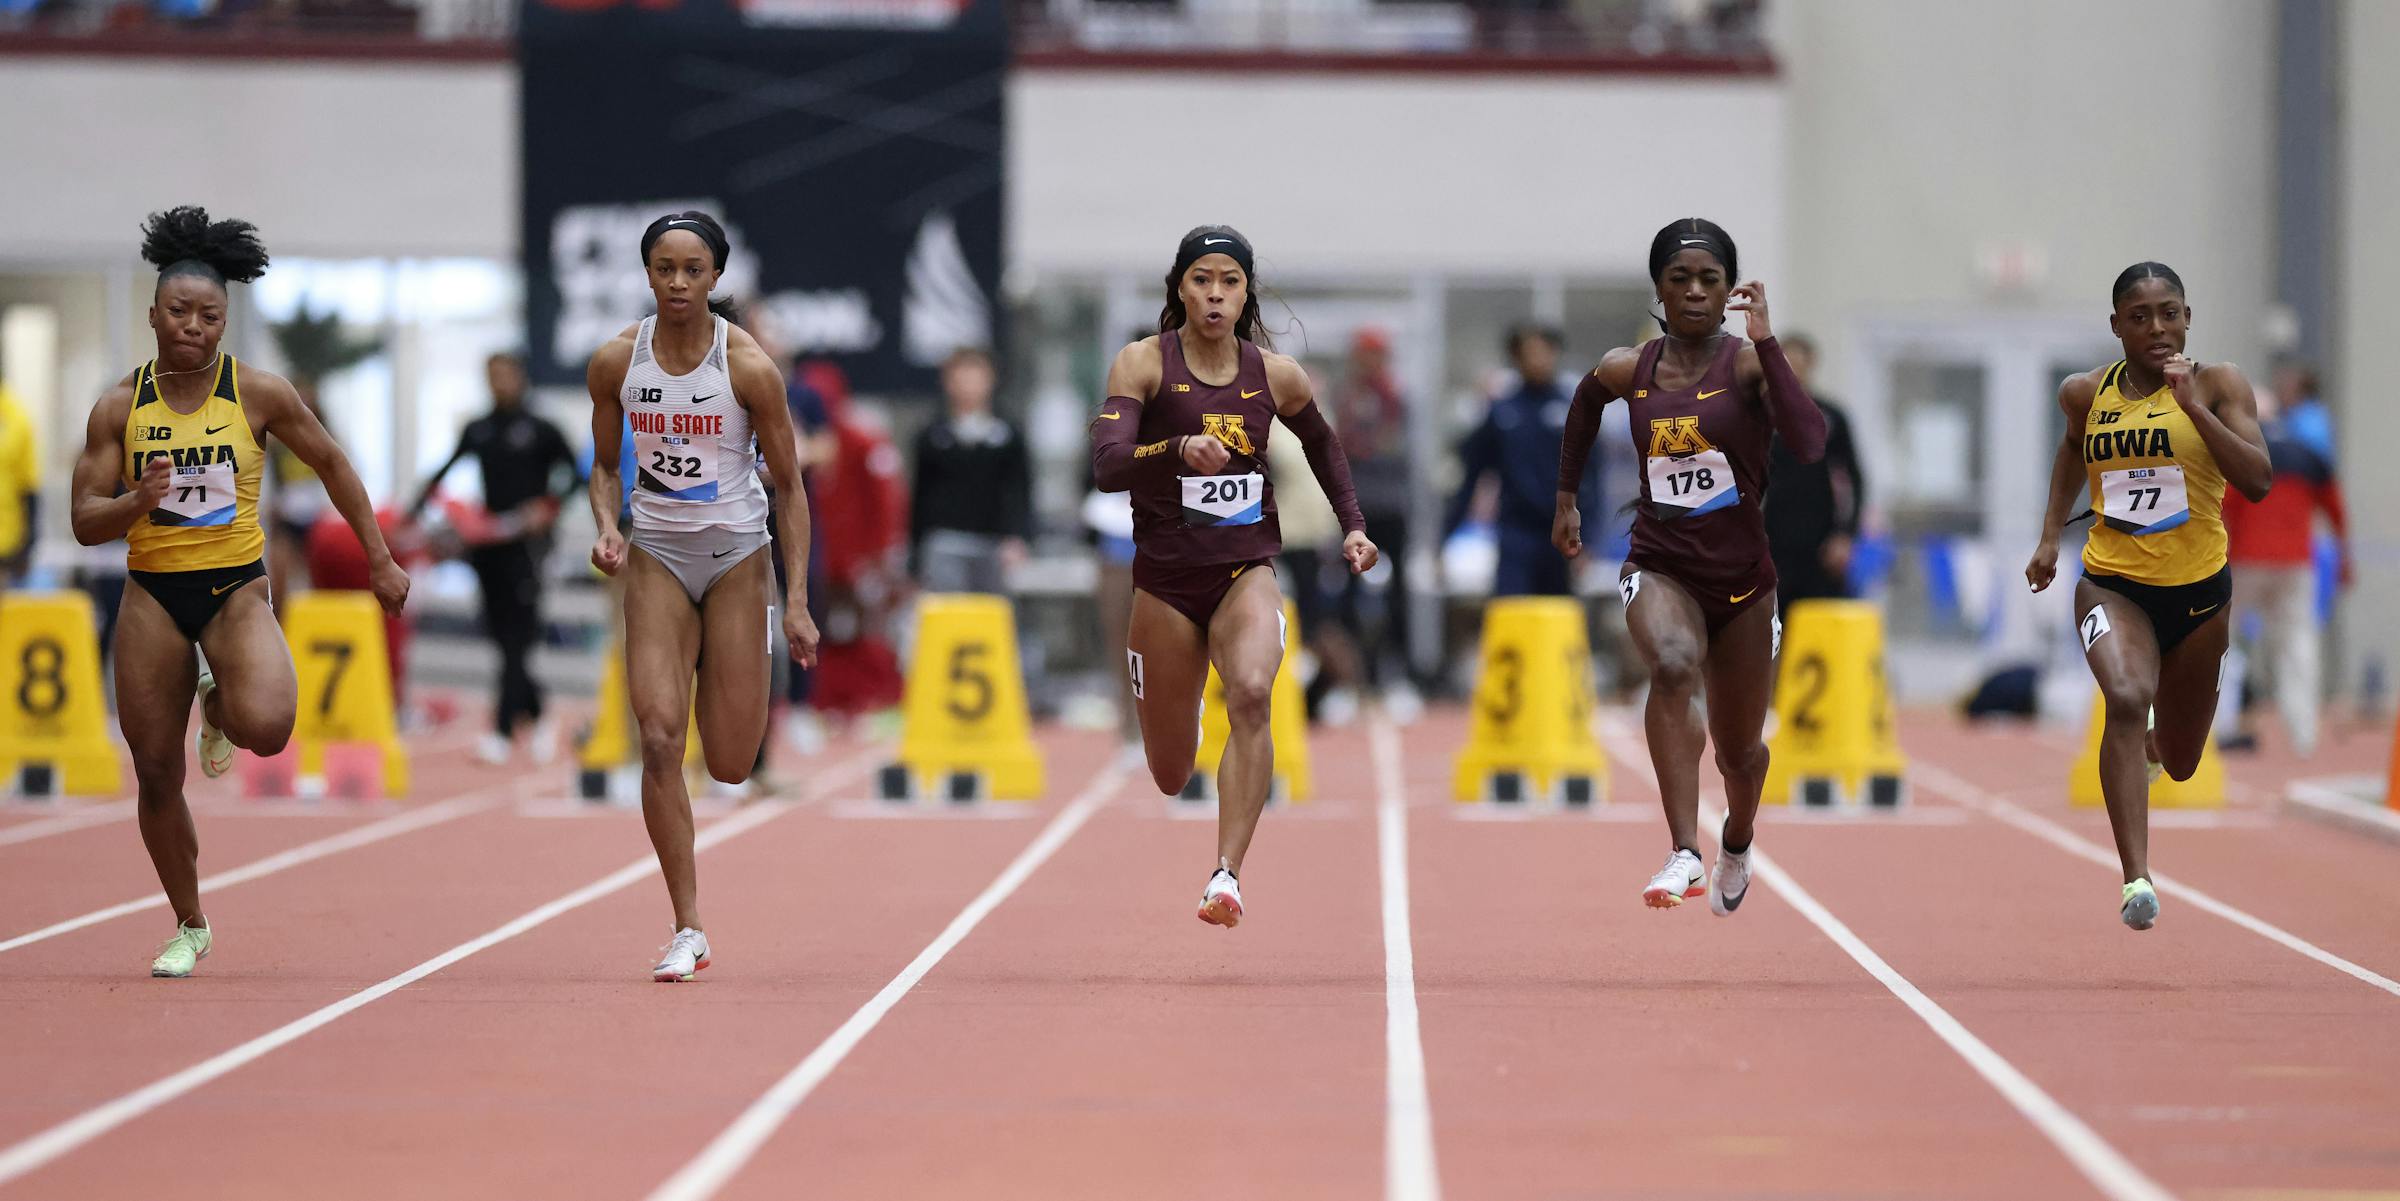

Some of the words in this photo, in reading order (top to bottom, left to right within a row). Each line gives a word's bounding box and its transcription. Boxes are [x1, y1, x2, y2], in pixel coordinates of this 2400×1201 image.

[630, 411, 666, 434] OHIO
[672, 413, 723, 435] STATE
[2085, 428, 2174, 464] IOWA
[651, 451, 702, 478] 232
[176, 485, 206, 503] 71
[1201, 478, 1248, 504] 201
[1666, 468, 1715, 496] 178
[2128, 487, 2161, 512] 77
[1622, 576, 1633, 602] 3
[2084, 614, 2104, 645] 2
[18, 638, 68, 718] 8
[308, 639, 352, 716] 7
[945, 643, 995, 722] 5
[1131, 655, 1141, 695] 4
[1485, 645, 1526, 724] 3
[1790, 653, 1829, 733] 2
